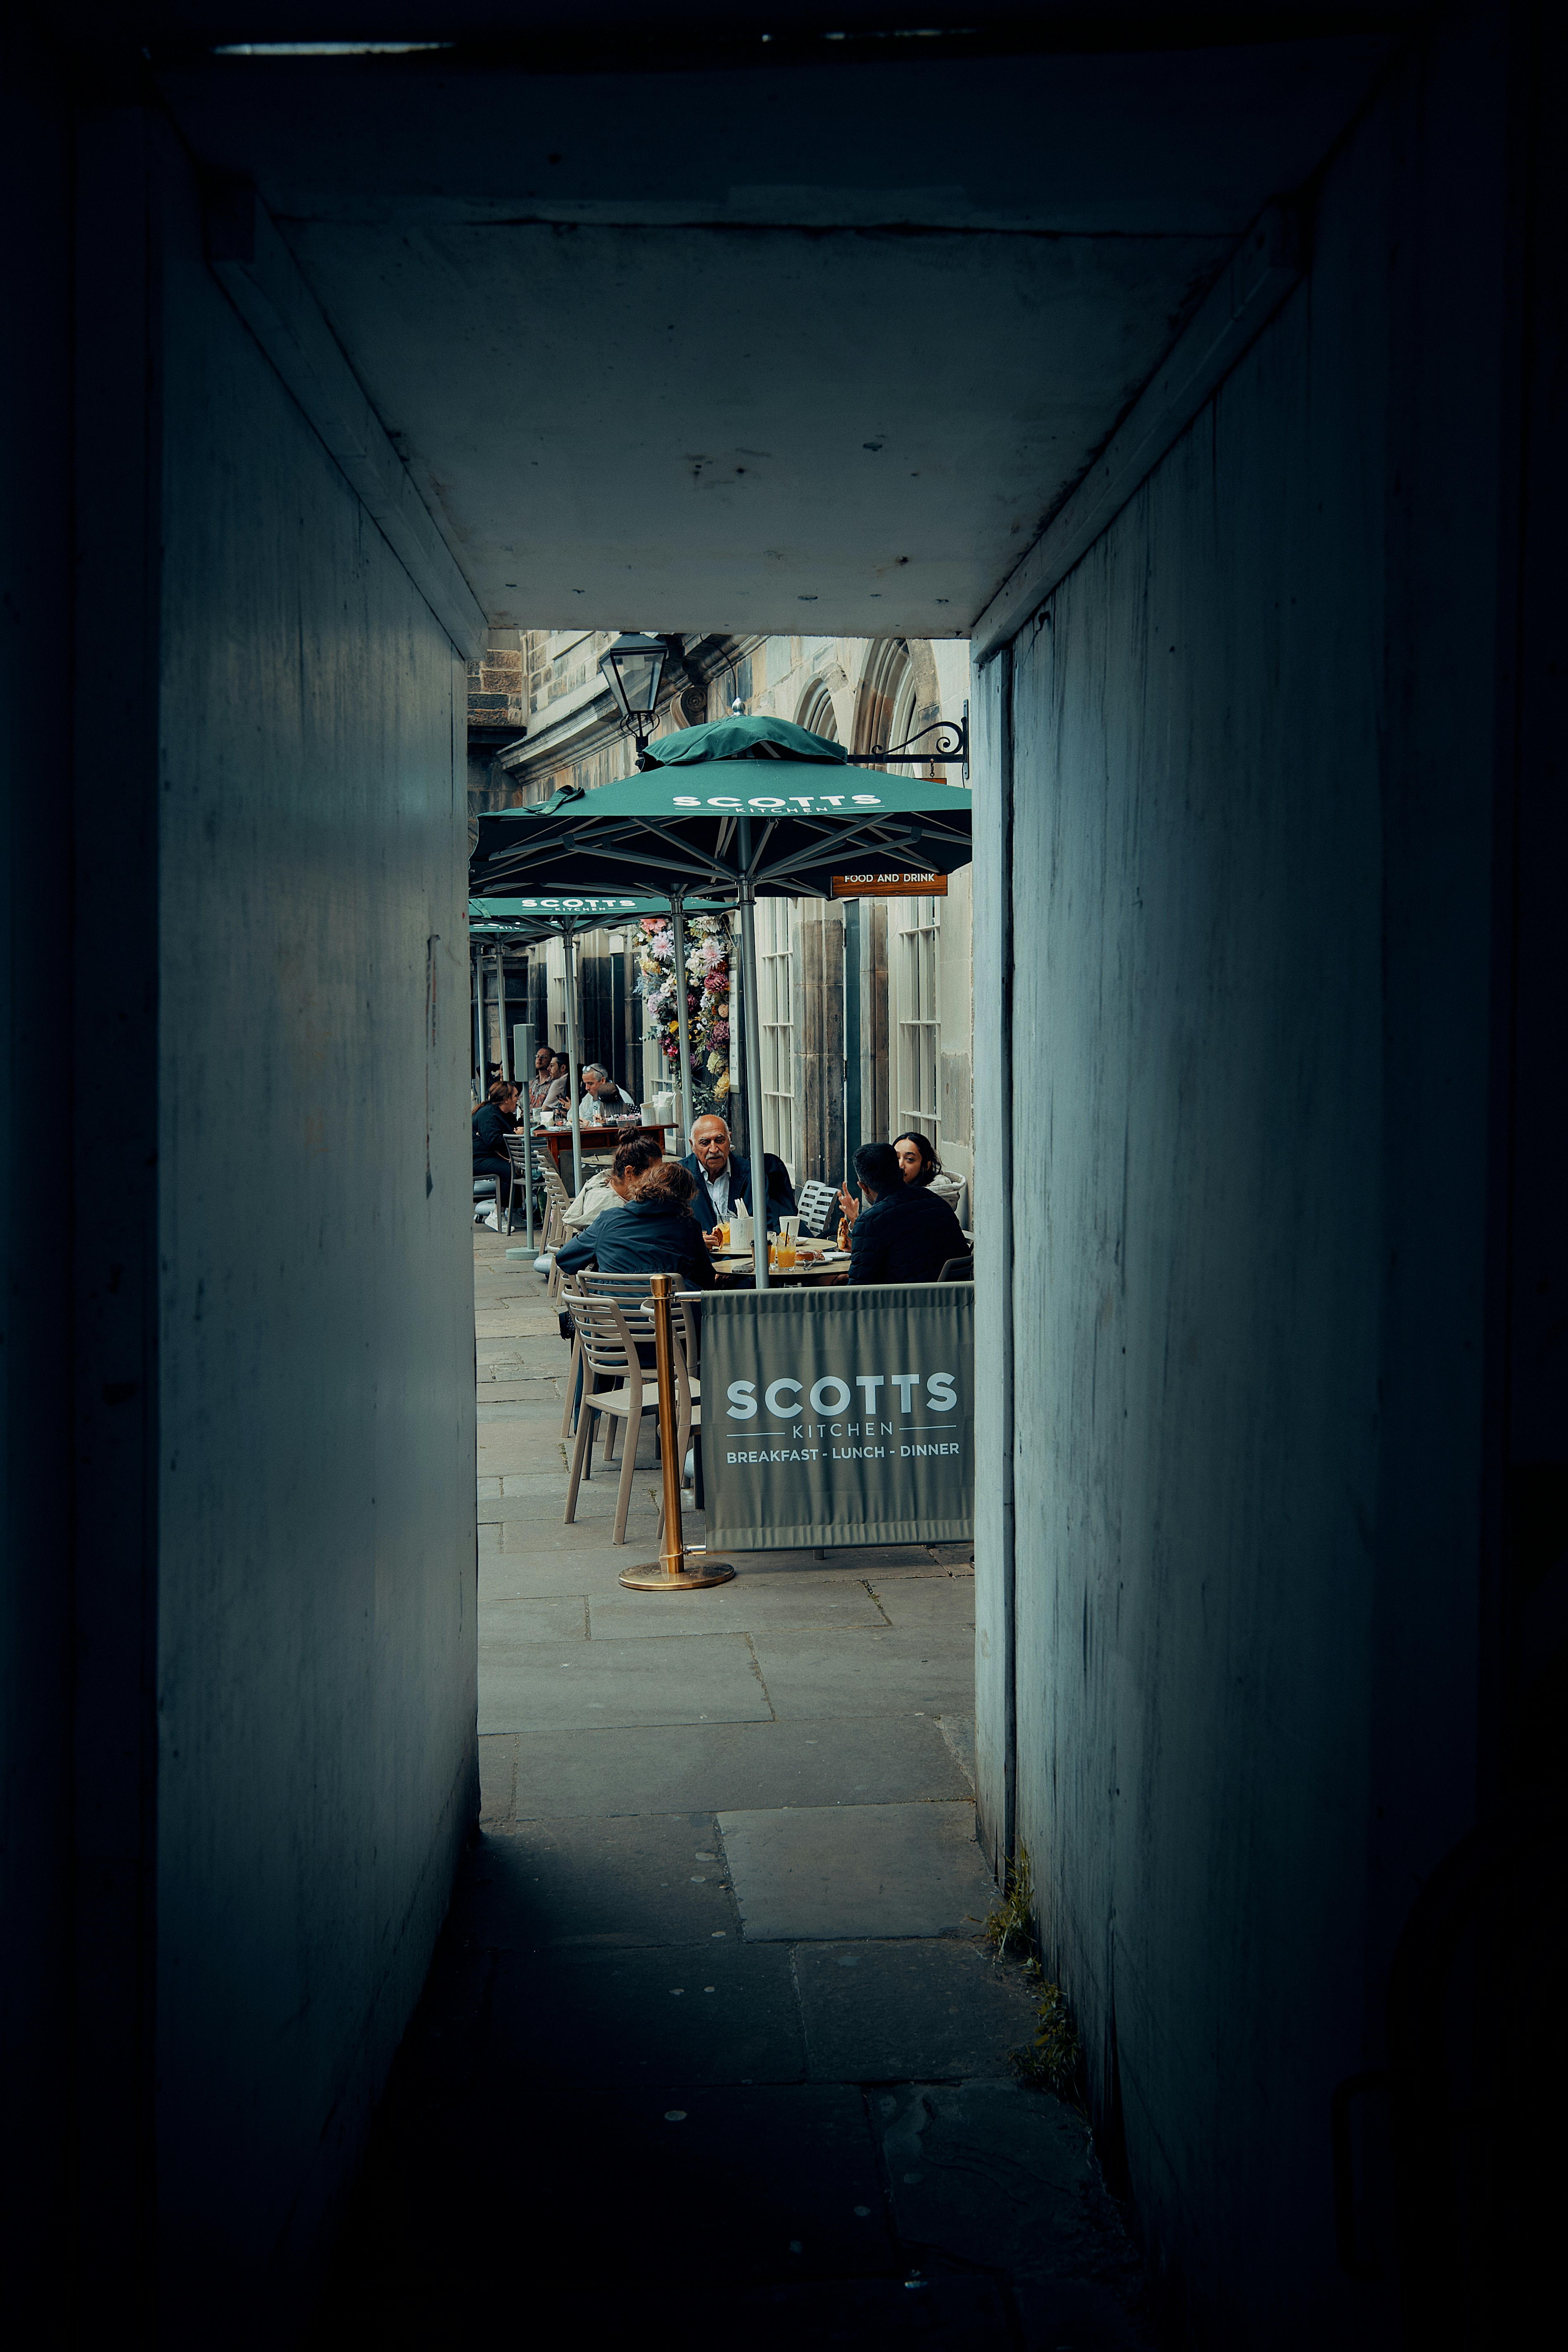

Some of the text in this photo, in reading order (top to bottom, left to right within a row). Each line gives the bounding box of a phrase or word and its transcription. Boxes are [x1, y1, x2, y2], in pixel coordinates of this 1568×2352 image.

[673, 794, 882, 807] SCOTTS
[877, 874, 899, 882] AND
[904, 873, 935, 882] DRINK
[521, 899, 636, 907] SCOTTS
[726, 1372, 957, 1419] SCOTTS
[793, 1422, 892, 1439] KITCHEN
[727, 1449, 819, 1463] BREAKFAST
[832, 1446, 884, 1459] LUNCH
[900, 1443, 959, 1457] DINNER
